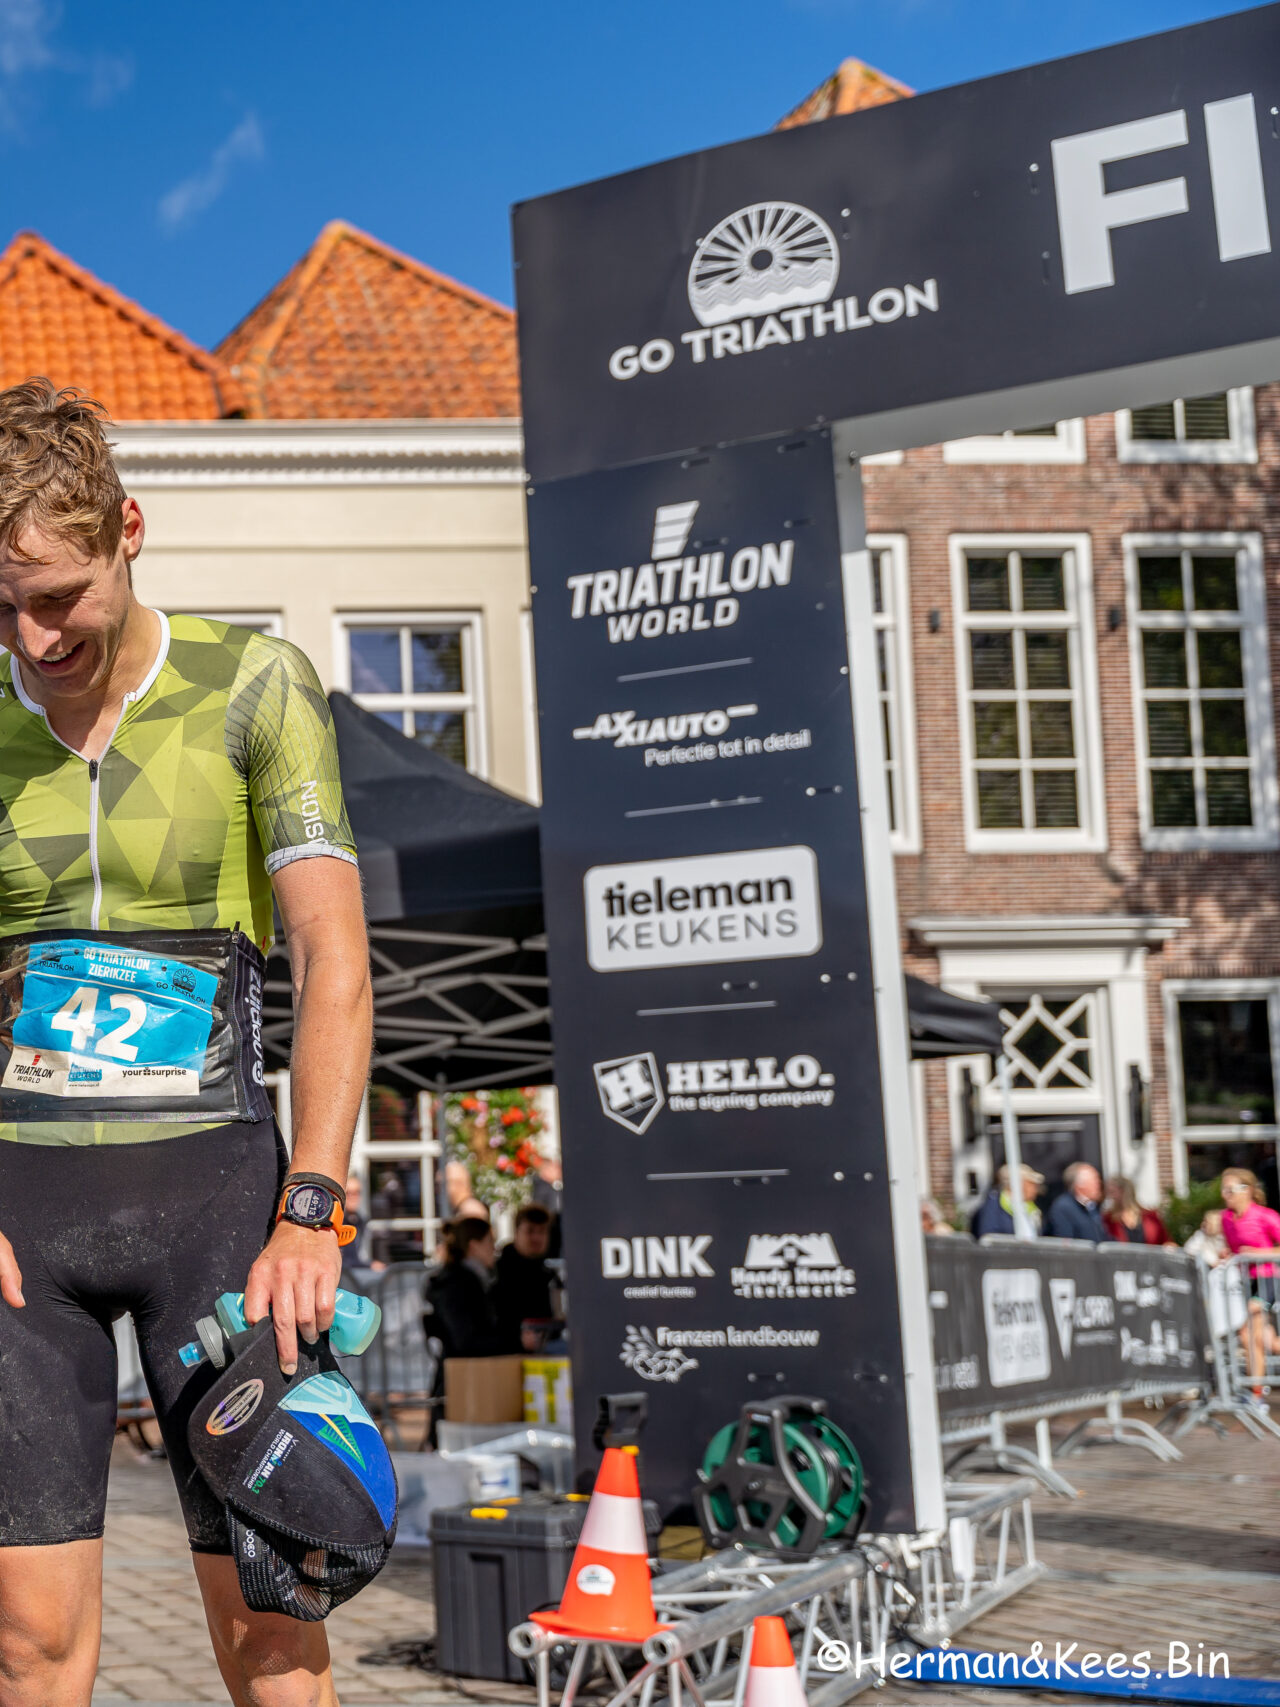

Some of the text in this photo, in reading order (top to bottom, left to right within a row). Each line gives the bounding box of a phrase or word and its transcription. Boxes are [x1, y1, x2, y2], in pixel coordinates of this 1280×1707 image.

[1050, 92, 1272, 295] FI
[609, 279, 939, 380] GO TRIATHLON
[567, 540, 795, 619] TRIATHLON
[607, 598, 739, 643] WORLD
[645, 729, 812, 768] Perfectie tot in detail
[602, 875, 793, 918] tieleman
[606, 909, 798, 951] KEUKENS
[40, 959, 74, 972] TRIATHLON
[83, 947, 150, 971] GO TRIATHLON
[88, 962, 137, 983] ZIERIKZEE
[156, 981, 168, 990] GO
[50, 986, 147, 1062] 42
[13, 1064, 54, 1079] TRIATHLON
[17, 1075, 41, 1084] WORLD
[151, 1067, 187, 1077] surprise
[667, 1055, 834, 1093] HELLO.
[669, 1089, 833, 1111] the signing company
[601, 1235, 715, 1279] DINK
[656, 1325, 820, 1347] Franzen landbouw
[270, 1428, 286, 1449] WORLD
[247, 1448, 273, 1489] CHAMPIONSHIP
